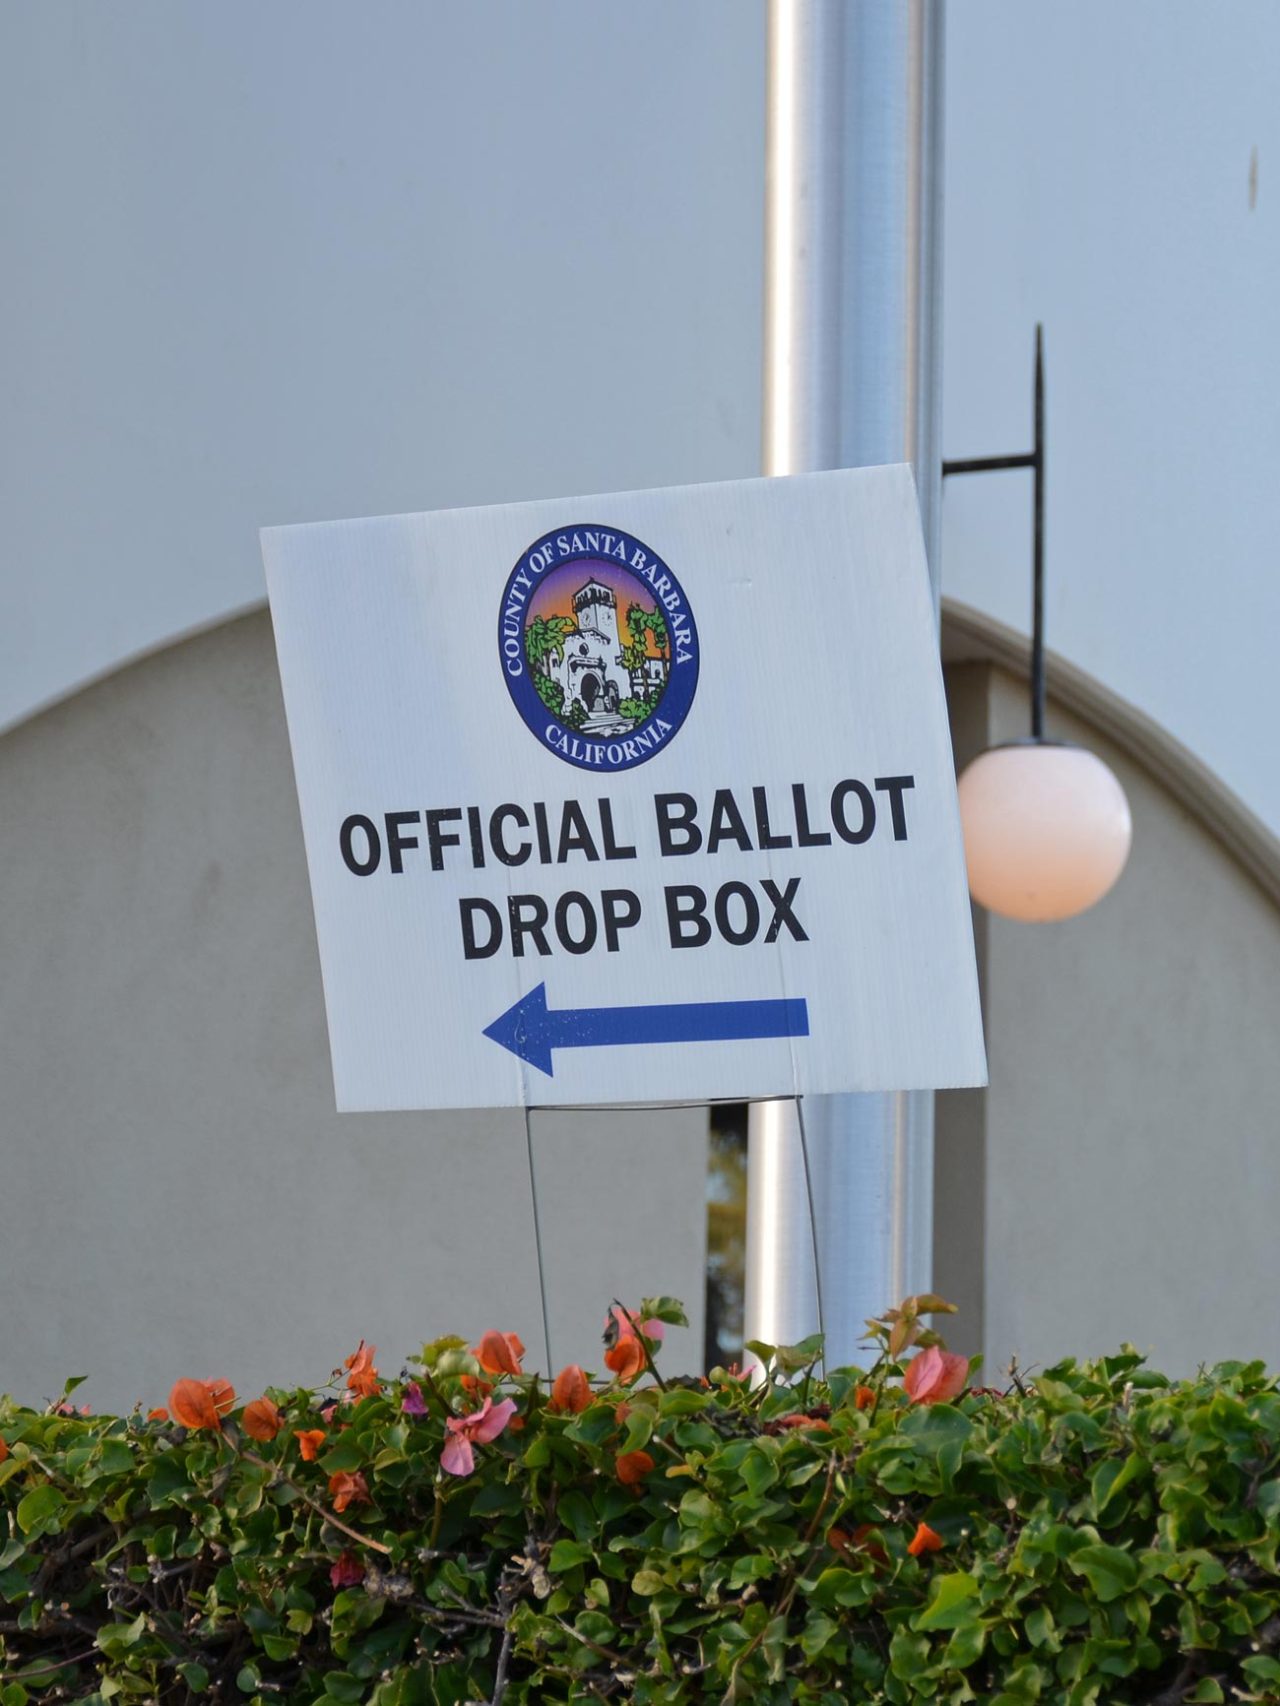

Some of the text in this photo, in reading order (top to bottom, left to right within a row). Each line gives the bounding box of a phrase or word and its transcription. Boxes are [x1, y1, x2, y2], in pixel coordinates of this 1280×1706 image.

[503, 531, 693, 676] COUNTY OF SANTA BARBARA
[545, 718, 672, 764] CALIFORNIA
[339, 775, 915, 876] OFFICIAL BALLOT
[458, 877, 810, 960] DROP BOX
